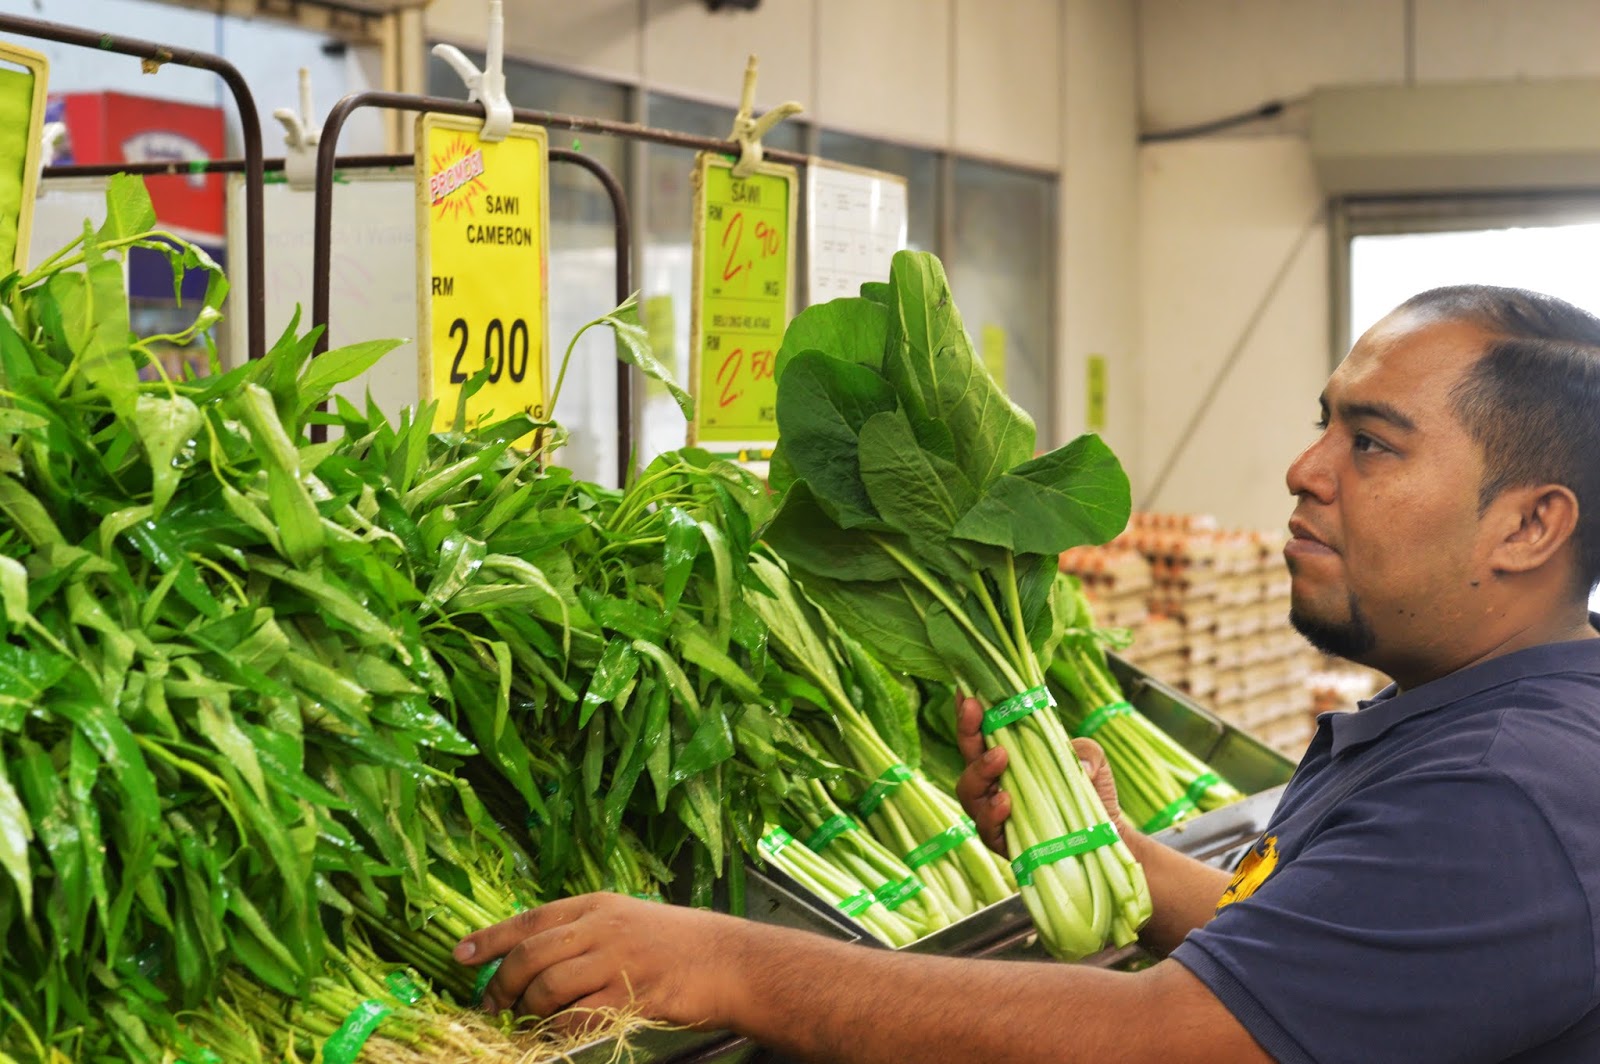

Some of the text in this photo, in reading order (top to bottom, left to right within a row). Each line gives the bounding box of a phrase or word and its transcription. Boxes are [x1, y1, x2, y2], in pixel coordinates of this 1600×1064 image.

[732, 181, 760, 204] SAWI
[485, 194, 519, 215] SAWI
[708, 204, 723, 222] RM
[466, 224, 532, 247] CAMERON
[431, 275, 454, 297] RM
[763, 280, 780, 298] KG
[448, 317, 529, 385] 200
[706, 334, 721, 351] RM
[525, 404, 544, 420] KG
